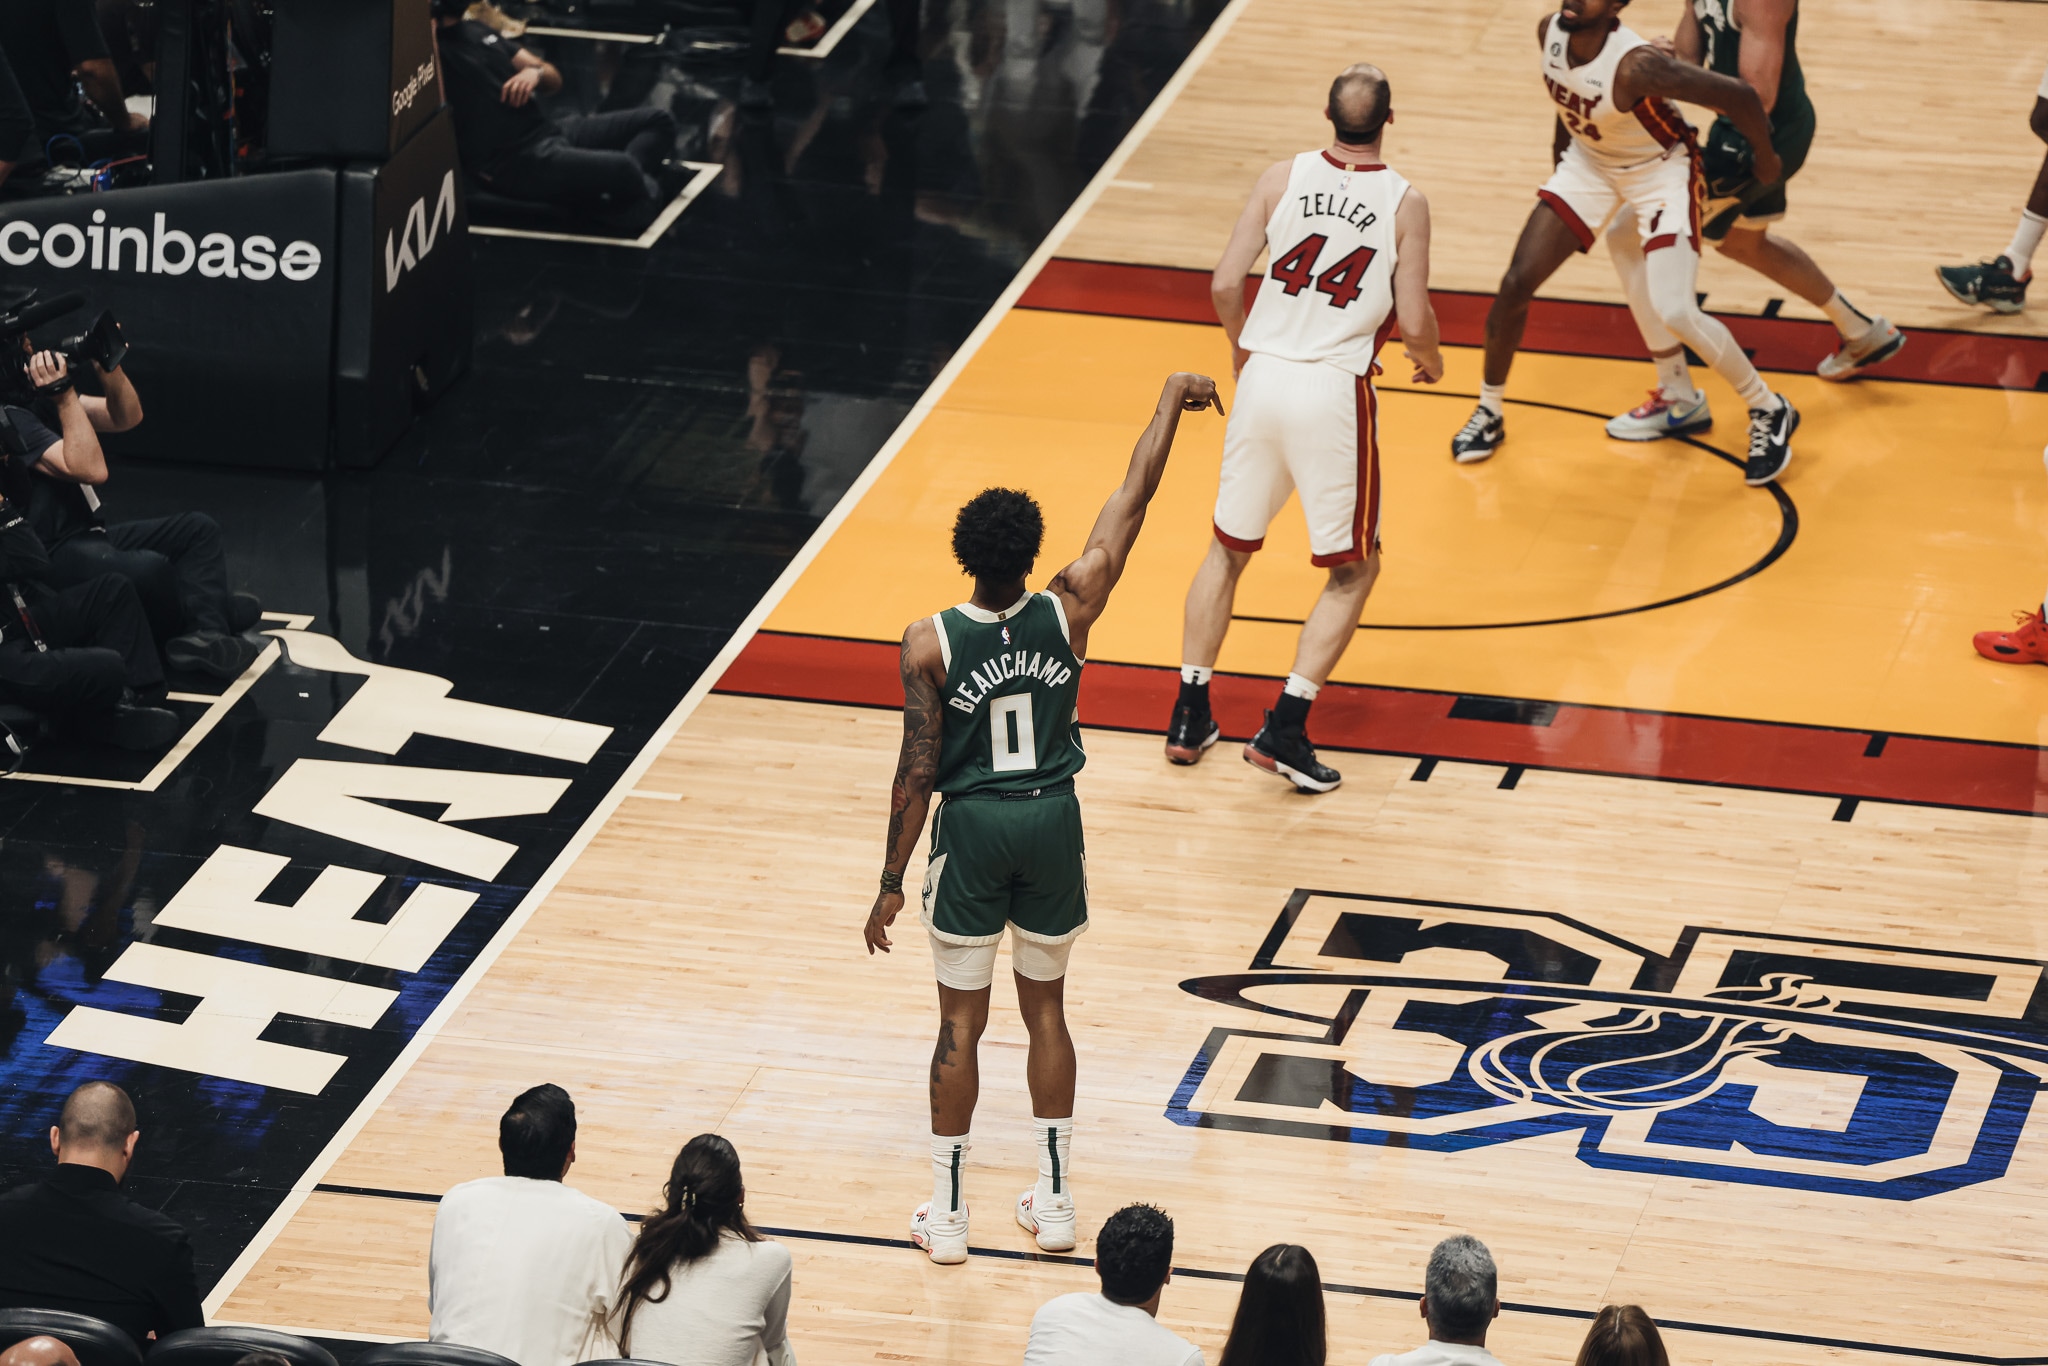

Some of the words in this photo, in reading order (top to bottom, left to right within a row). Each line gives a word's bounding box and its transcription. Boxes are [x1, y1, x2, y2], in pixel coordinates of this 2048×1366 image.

[393, 75, 417, 116] Google
[417, 54, 434, 90] Pixel
[1565, 111, 1603, 141] 24
[0, 209, 321, 281] coinbase
[1299, 193, 1377, 233] ZELLER
[1271, 232, 1378, 310] 44
[948, 650, 1072, 714] BEAUCHAMP
[990, 692, 1037, 772] 0
[43, 629, 614, 1096] HEAT
